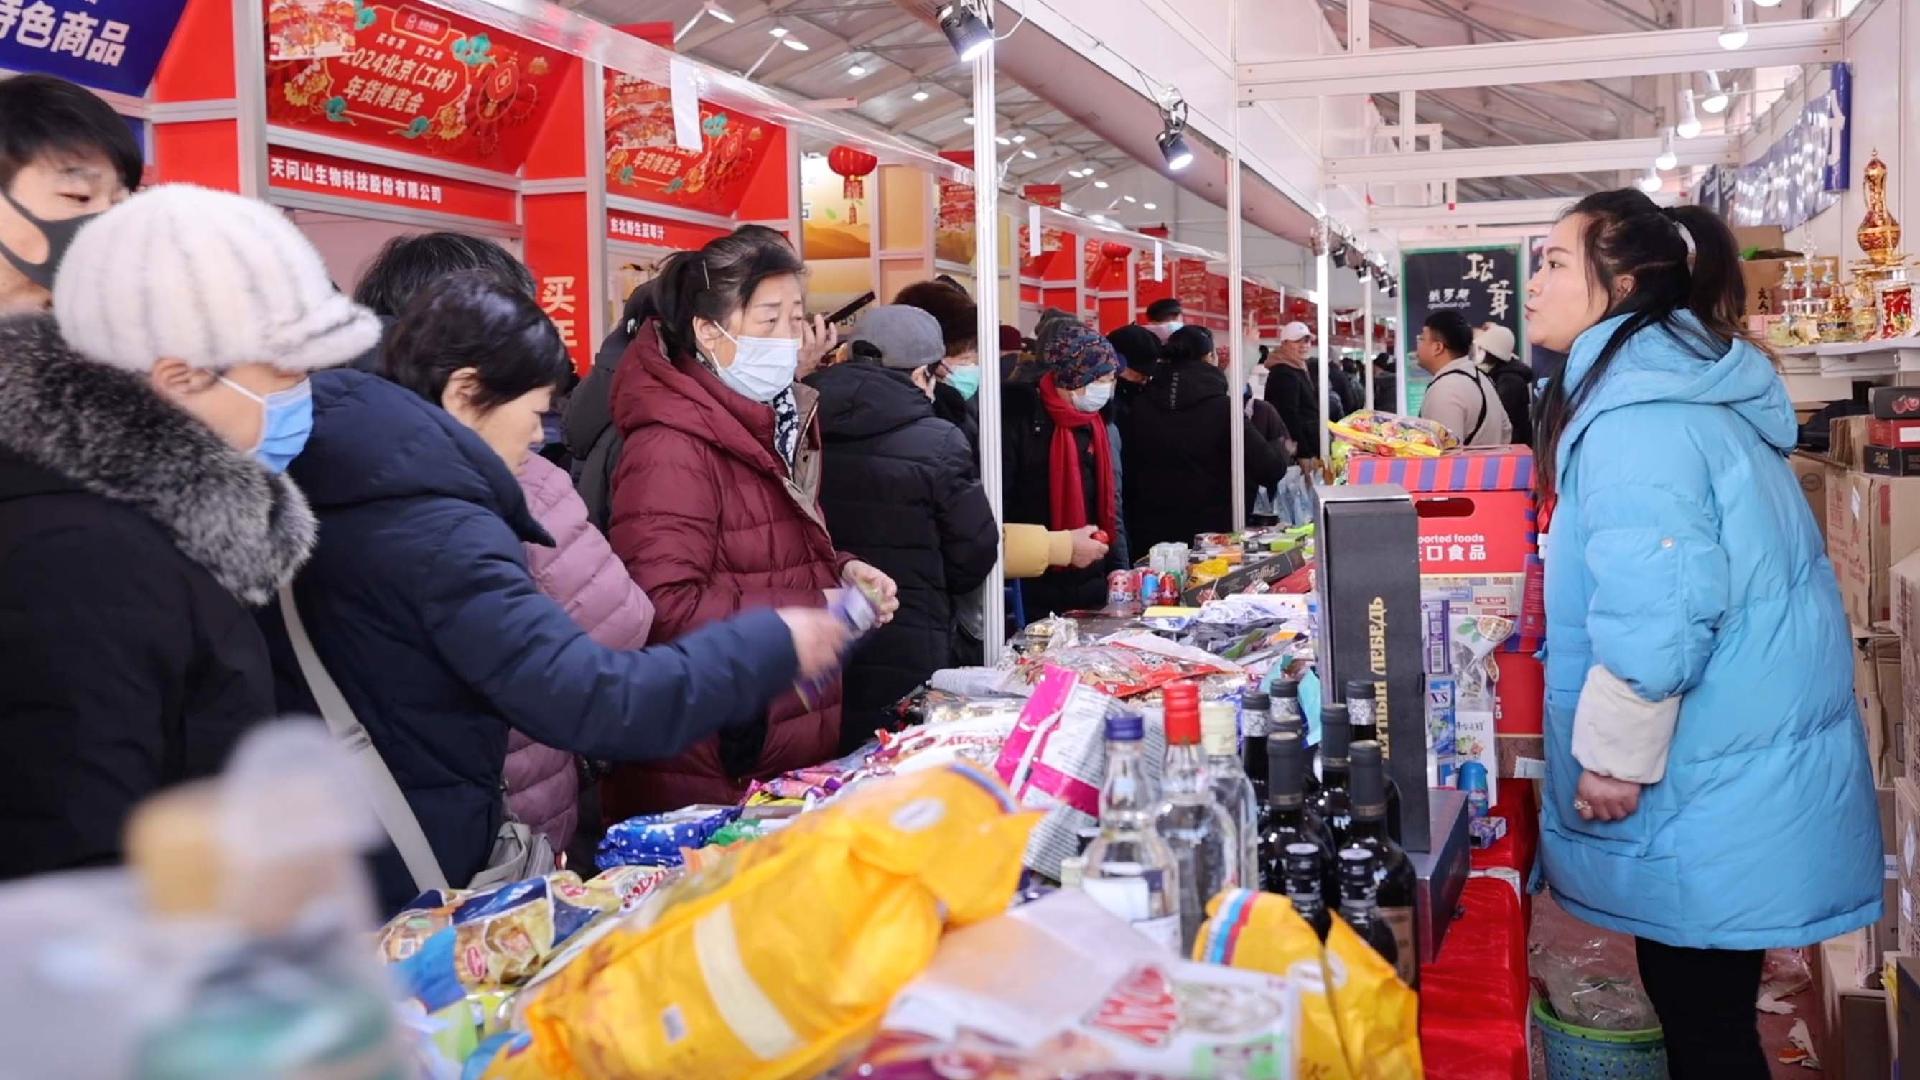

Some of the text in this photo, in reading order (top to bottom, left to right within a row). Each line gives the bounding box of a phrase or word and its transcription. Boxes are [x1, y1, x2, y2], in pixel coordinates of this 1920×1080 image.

[343, 75, 424, 114] 年货博览会
[271, 157, 442, 203] 天问山生物科技股份有限公司
[1418, 533, 1485, 544] ported foods
[1419, 544, 1486, 561] 口食品
[1368, 596, 1387, 675] ЛЕБЕДЬ
